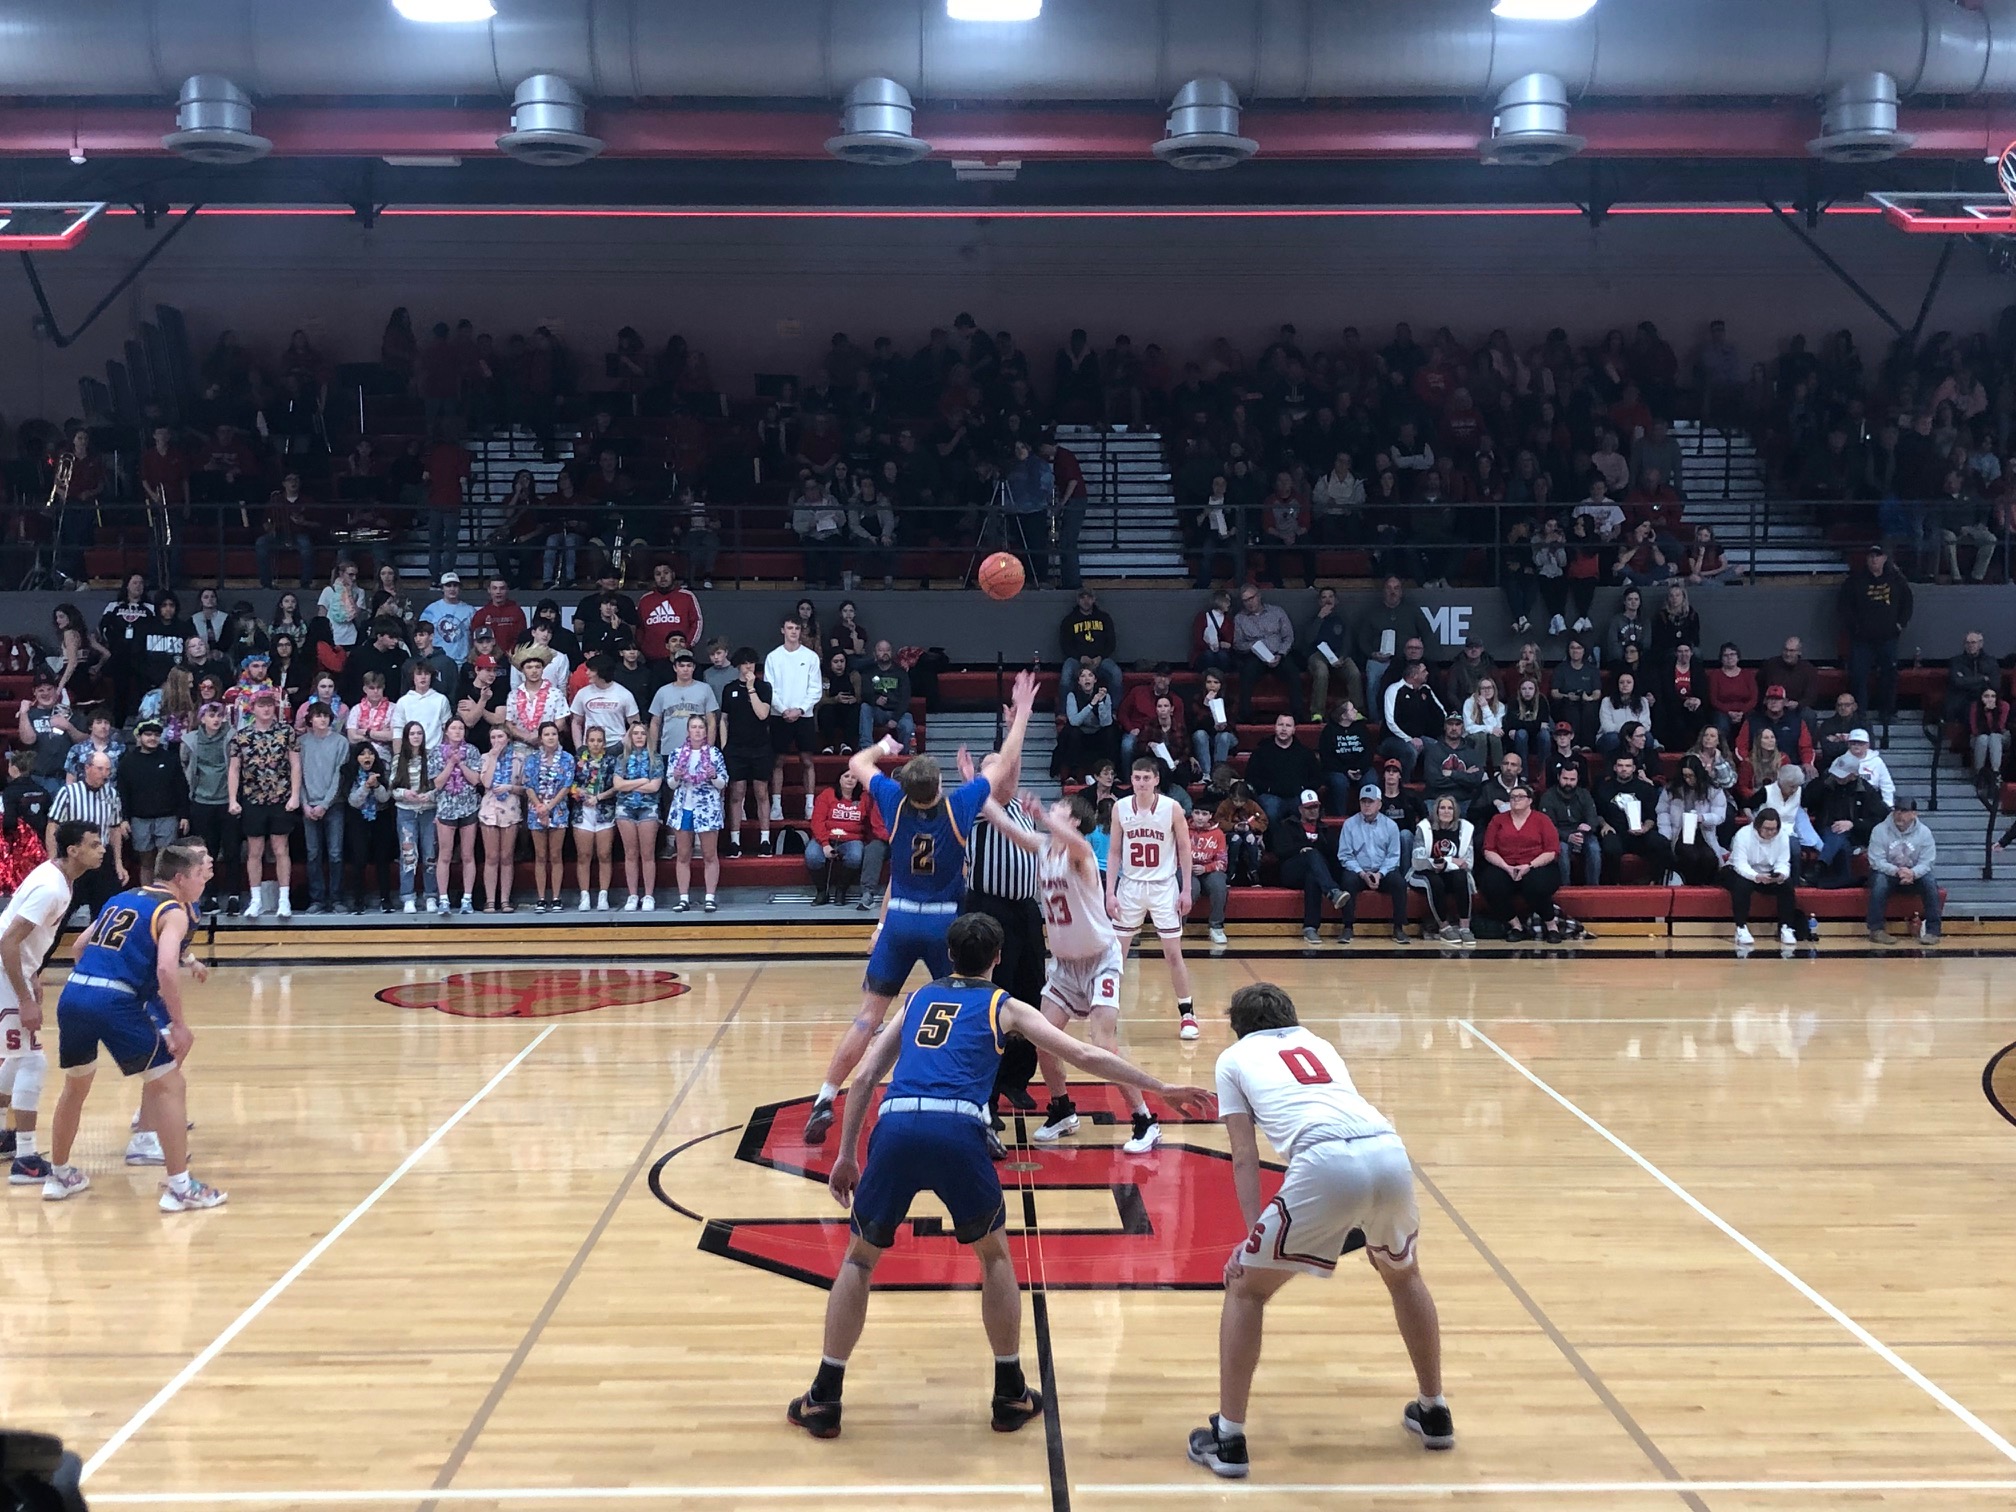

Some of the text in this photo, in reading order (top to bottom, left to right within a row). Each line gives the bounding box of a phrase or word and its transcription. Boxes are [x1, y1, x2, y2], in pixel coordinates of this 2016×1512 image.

[646, 614, 681, 626] adidas
[1127, 828, 1165, 842] BEARCATS
[911, 833, 935, 876] 2
[1130, 842, 1160, 868] 20
[1045, 894, 1073, 926] 13
[88, 905, 139, 952] 12
[1102, 978, 1115, 998] S
[6, 1029, 21, 1050] S
[914, 1002, 963, 1049] 5
[1279, 1046, 1333, 1085] 0
[1246, 1222, 1267, 1255] S
